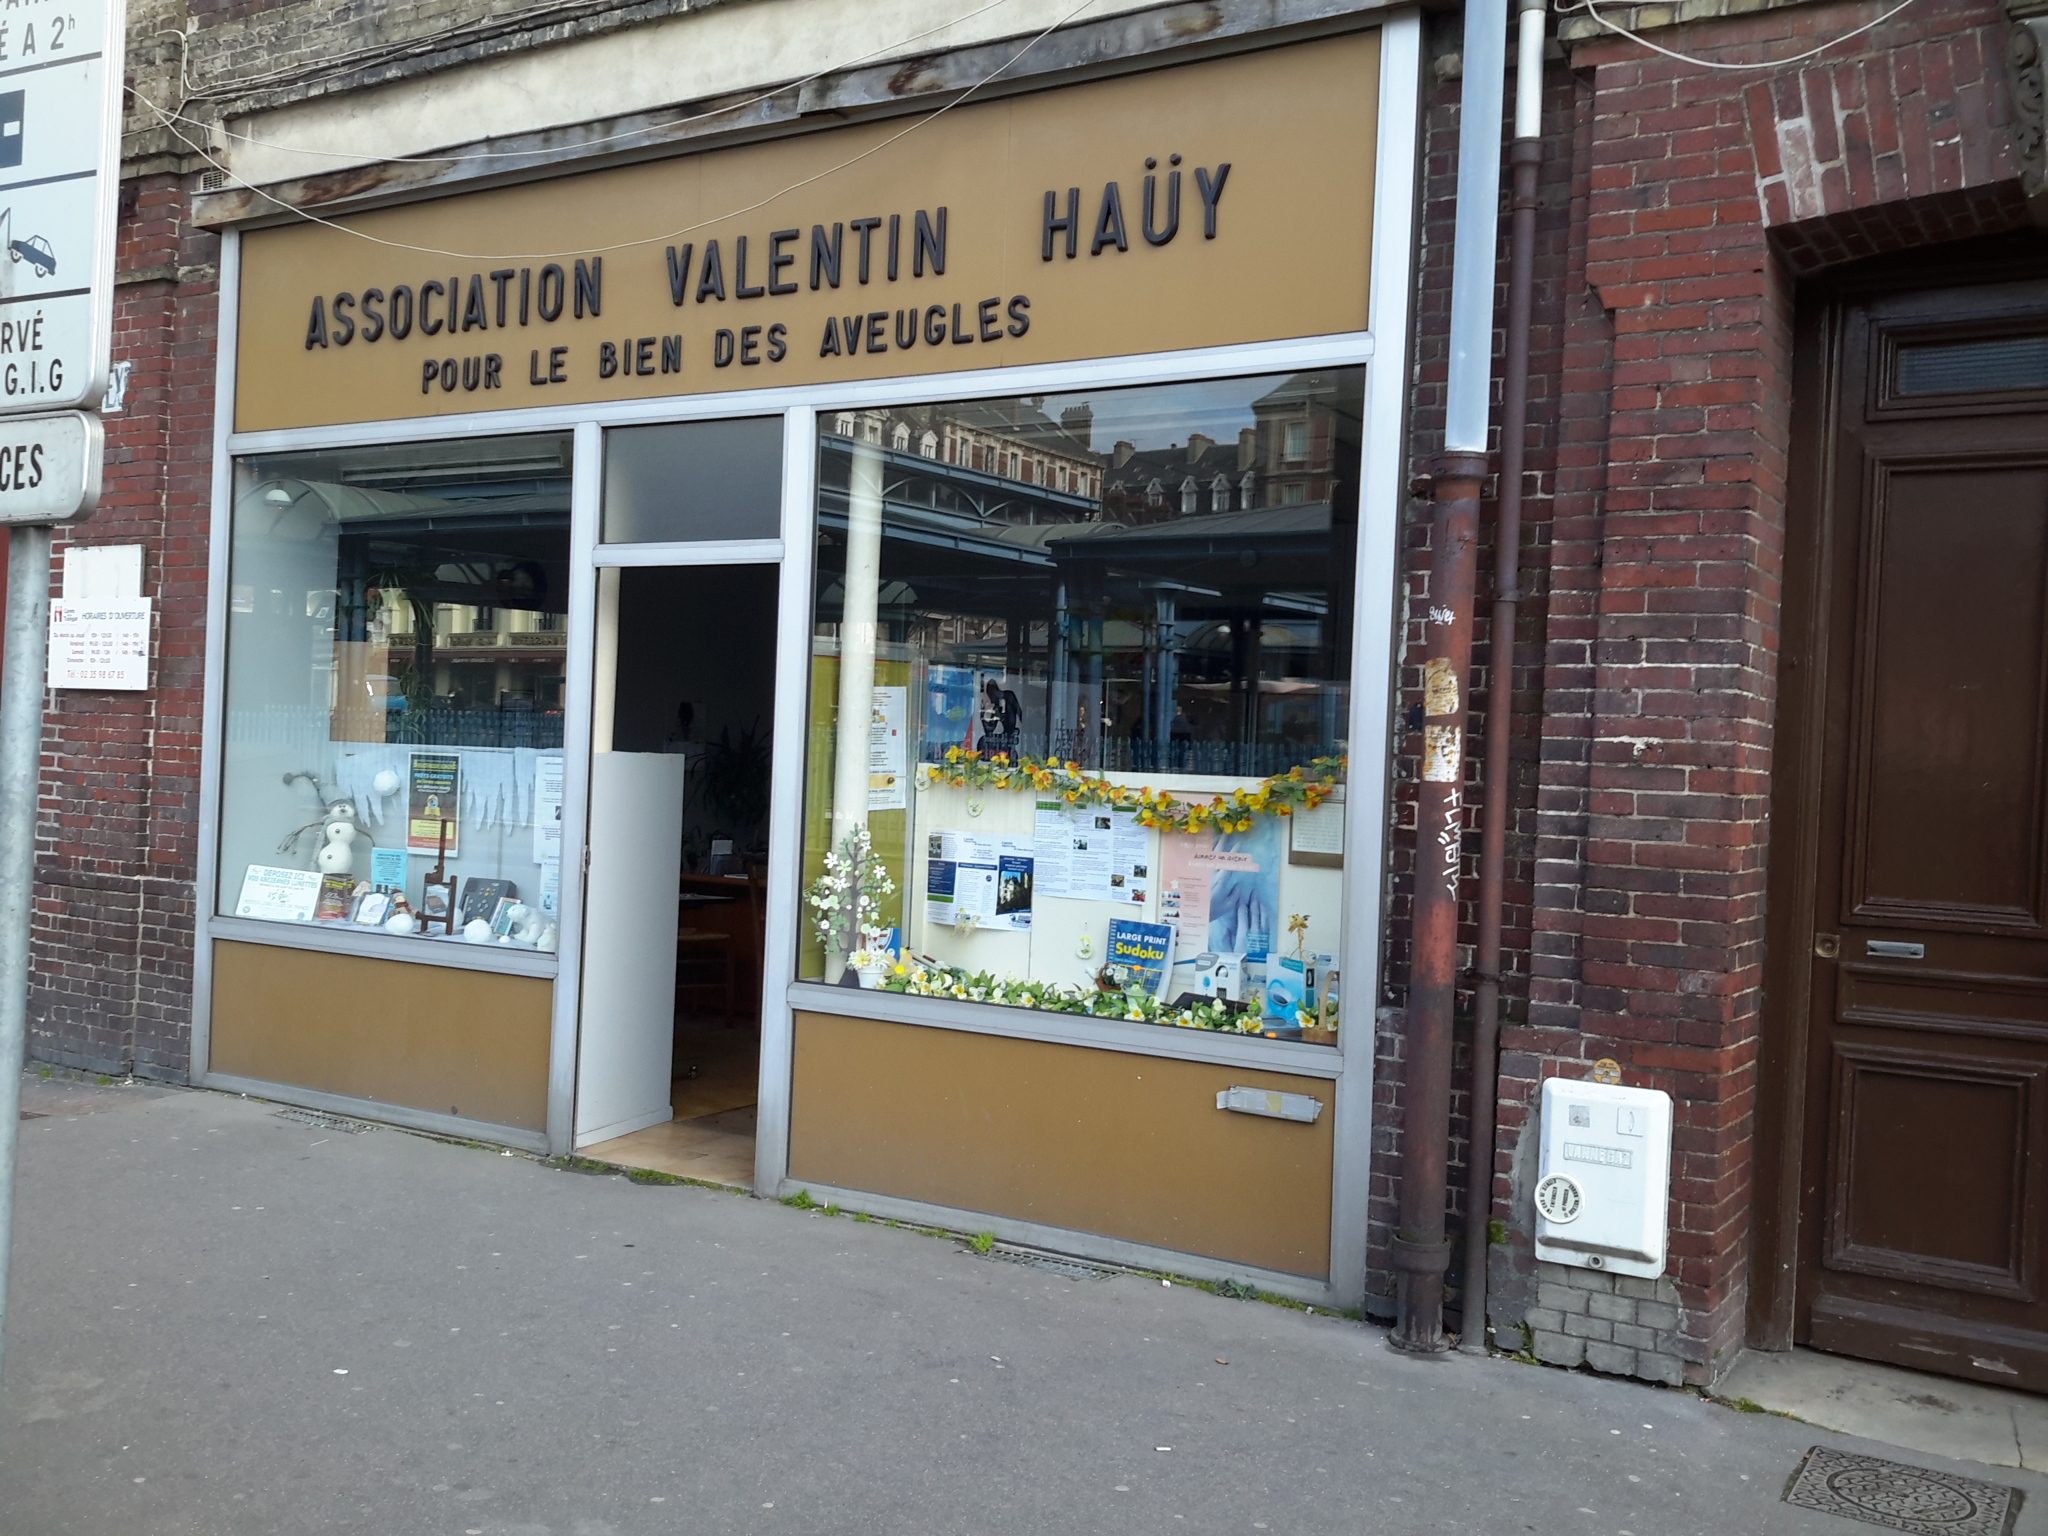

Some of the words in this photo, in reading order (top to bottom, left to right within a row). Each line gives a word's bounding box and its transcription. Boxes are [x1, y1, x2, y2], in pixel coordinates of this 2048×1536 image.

[22, 23, 36, 56] A
[304, 256, 603, 350] ASSOCIATION
[665, 206, 948, 307] VALENTIN
[1041, 153, 1232, 262] HAÜY
[1, 309, 44, 354] RVÉ
[421, 353, 502, 394] POUR
[530, 346, 569, 385] LE
[599, 334, 682, 379] BIEN
[714, 323, 788, 368] DES
[819, 295, 1031, 358] AVEUGLES
[0, 443, 44, 492] CES
[1115, 942, 1165, 960] Sudoku
[1116, 931, 1142, 942] LARGE
[1143, 935, 1167, 945] PRINT
